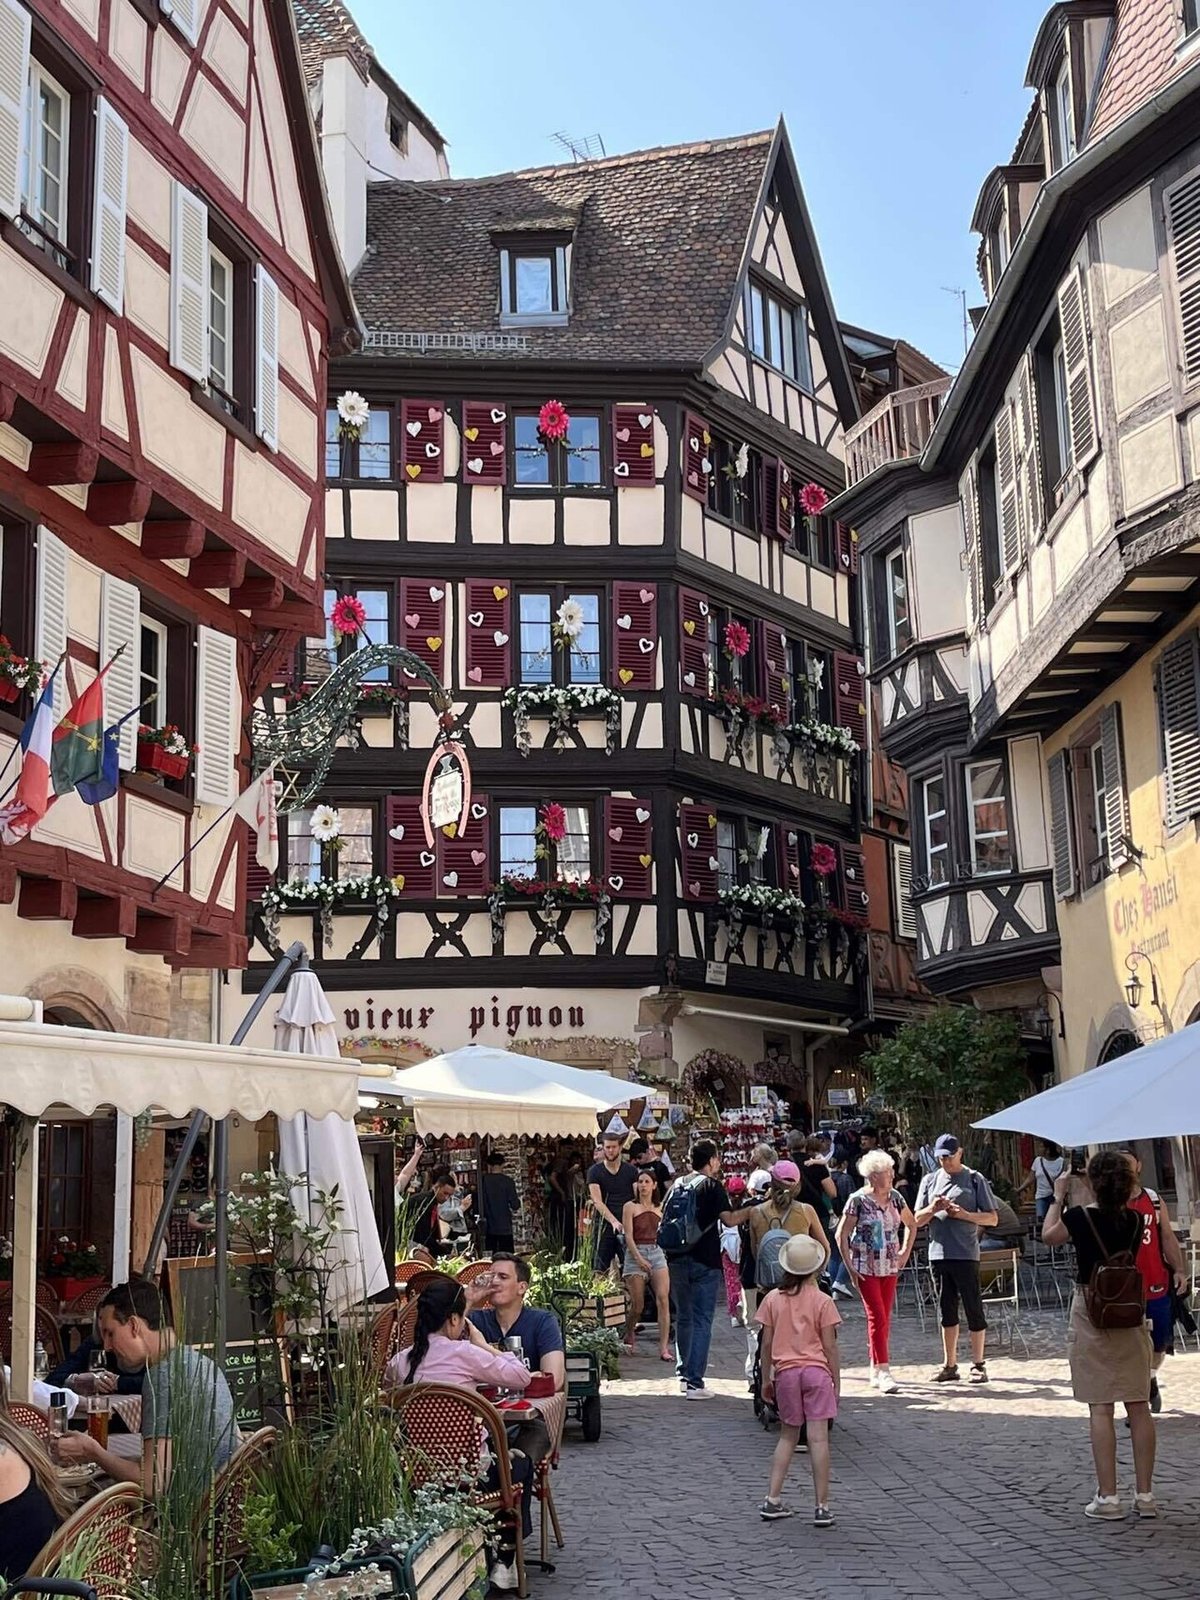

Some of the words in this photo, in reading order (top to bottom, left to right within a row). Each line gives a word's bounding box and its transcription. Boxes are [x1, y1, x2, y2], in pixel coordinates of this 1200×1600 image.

[1113, 896, 1139, 937] Chez
[343, 997, 435, 1031] vieux
[468, 995, 585, 1038] pignon
